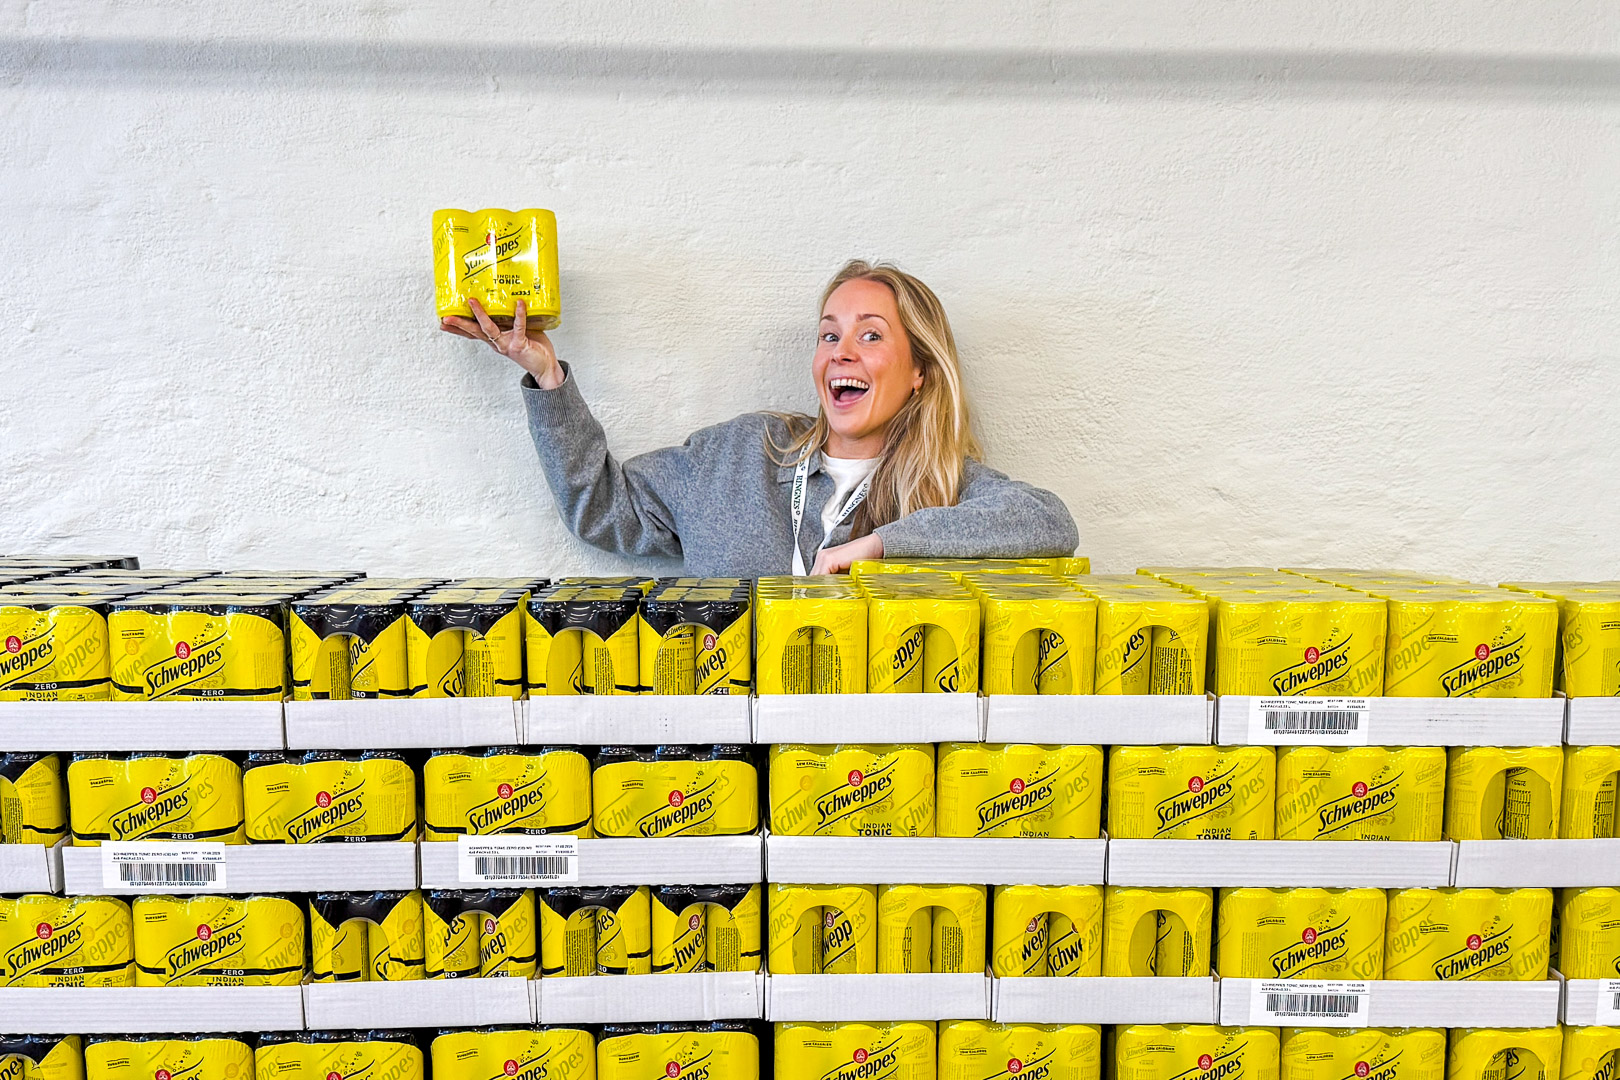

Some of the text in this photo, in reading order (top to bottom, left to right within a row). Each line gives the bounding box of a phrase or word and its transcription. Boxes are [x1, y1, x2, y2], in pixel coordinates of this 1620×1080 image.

[793, 475, 804, 510] RINGNES
[0, 637, 53, 677] weppes
[146, 646, 222, 697] Schweppes
[1273, 650, 1348, 696] Schweppes
[1442, 648, 1520, 697] Schweppes
[112, 792, 187, 841] Schweppes
[288, 796, 362, 843] Schweppes
[470, 786, 543, 835] Schweppes
[640, 795, 712, 838] Schweppes
[817, 772, 892, 826] Schweppes
[978, 784, 1052, 830] Schweppes
[1158, 778, 1232, 830] Schweppes
[1318, 788, 1394, 832] Schweppes
[8, 924, 81, 978] Schweppes
[169, 929, 242, 978] Schweppes
[1272, 932, 1345, 978] Schweppes
[1435, 938, 1509, 980] Schweppes
[826, 1051, 896, 1080] hweppes
